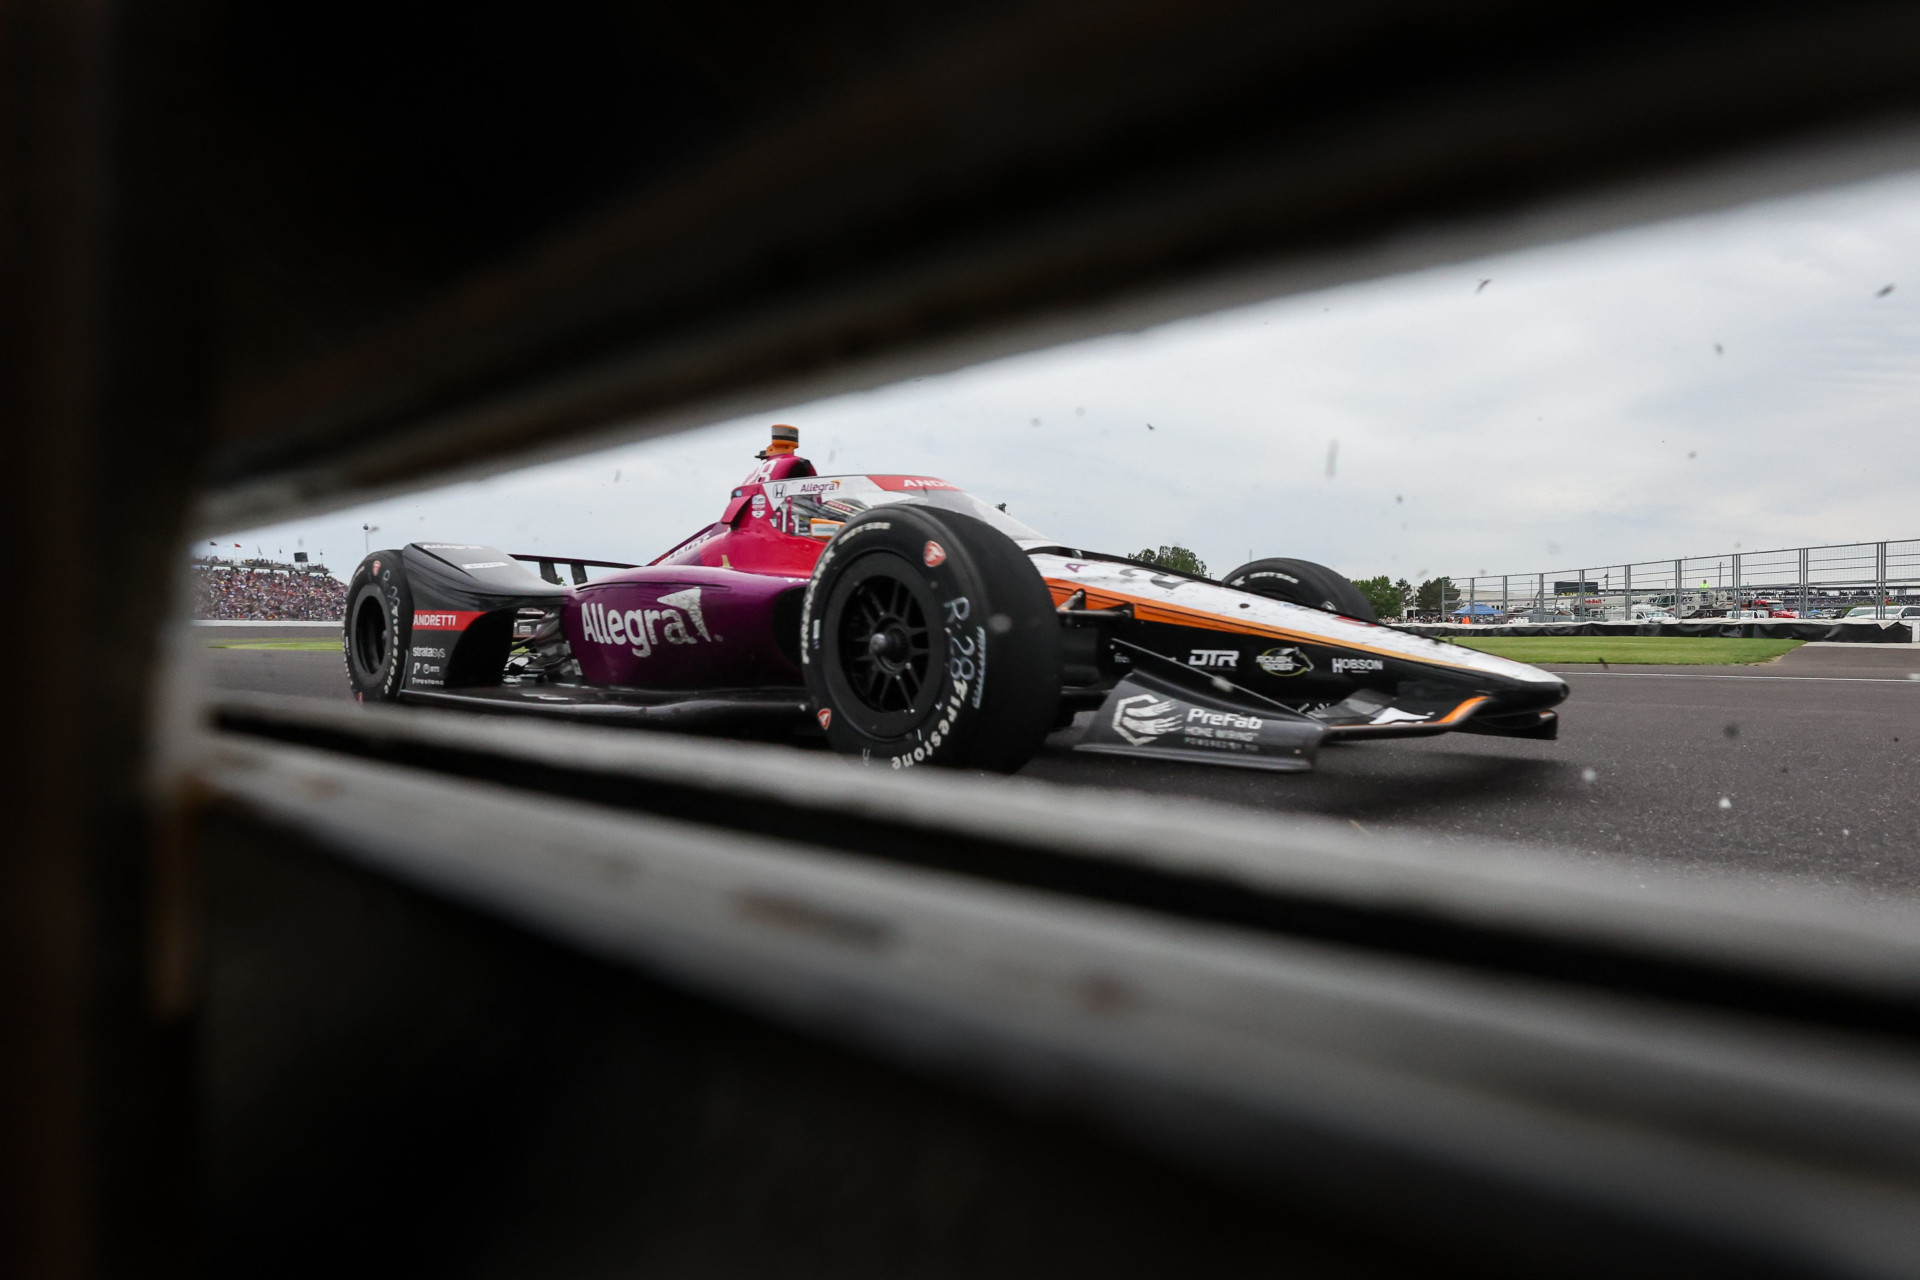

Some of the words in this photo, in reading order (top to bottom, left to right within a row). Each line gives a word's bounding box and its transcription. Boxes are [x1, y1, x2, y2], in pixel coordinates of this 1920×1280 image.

[800, 482, 835, 493] Allegra
[412, 614, 457, 627] ANDRETTI
[580, 602, 698, 658] Allegra
[1188, 649, 1240, 667] DTR
[1332, 658, 1384, 674] HOBSON
[891, 679, 969, 770] Firestone
[1186, 707, 1263, 730] PreFab
